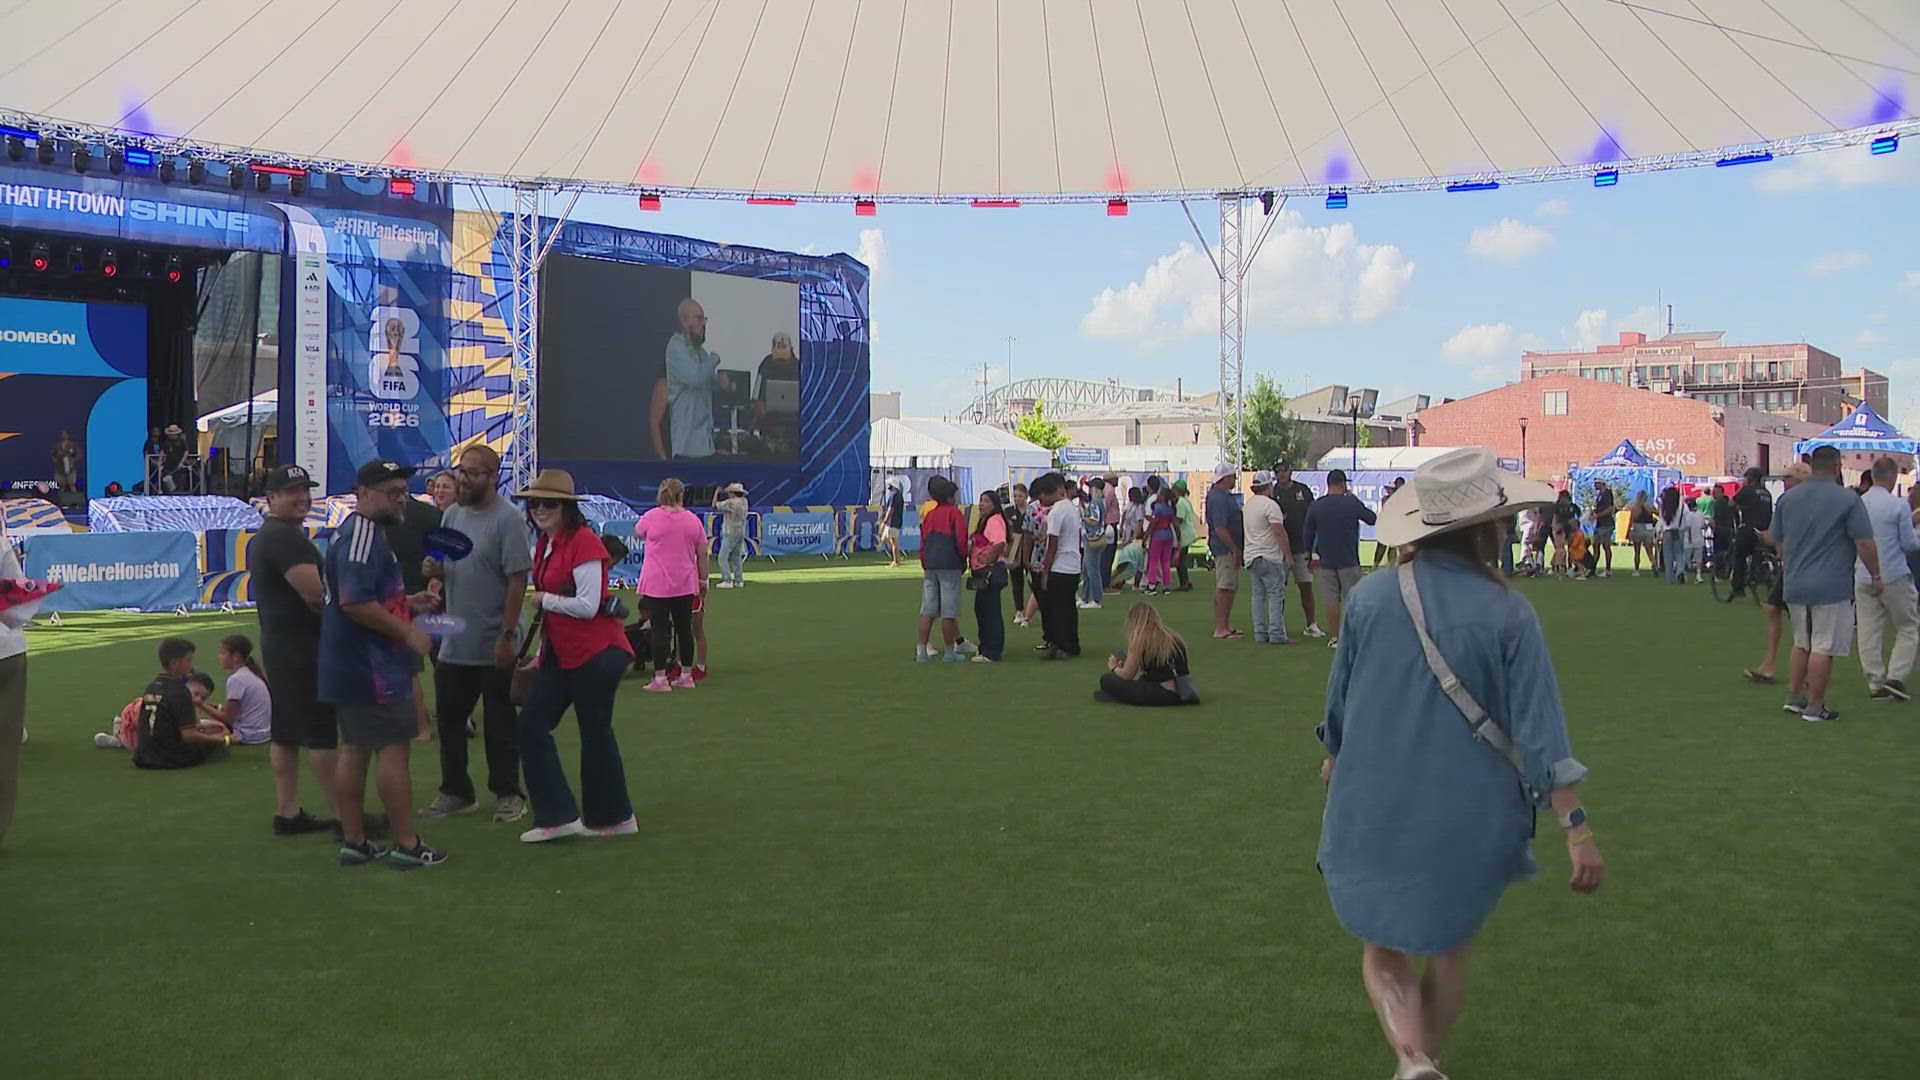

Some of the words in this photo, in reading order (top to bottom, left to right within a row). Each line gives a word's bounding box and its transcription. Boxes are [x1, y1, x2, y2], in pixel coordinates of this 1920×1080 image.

[0, 183, 44, 208] THAT
[47, 188, 124, 218] H-TOWN
[130, 199, 249, 233] SHINE
[334, 216, 439, 245] #FIFAFanFestival
[383, 380, 406, 392] FIFA
[368, 402, 400, 412] WORLD
[402, 403, 420, 412] CUP
[368, 412, 420, 428] 2026
[1635, 439, 1675, 451] EAST
[1648, 452, 1697, 465] OCKS
[777, 535, 821, 546] HOUSTON
[46, 560, 180, 584] #WeAreHouston
[144, 704, 158, 730] 7
